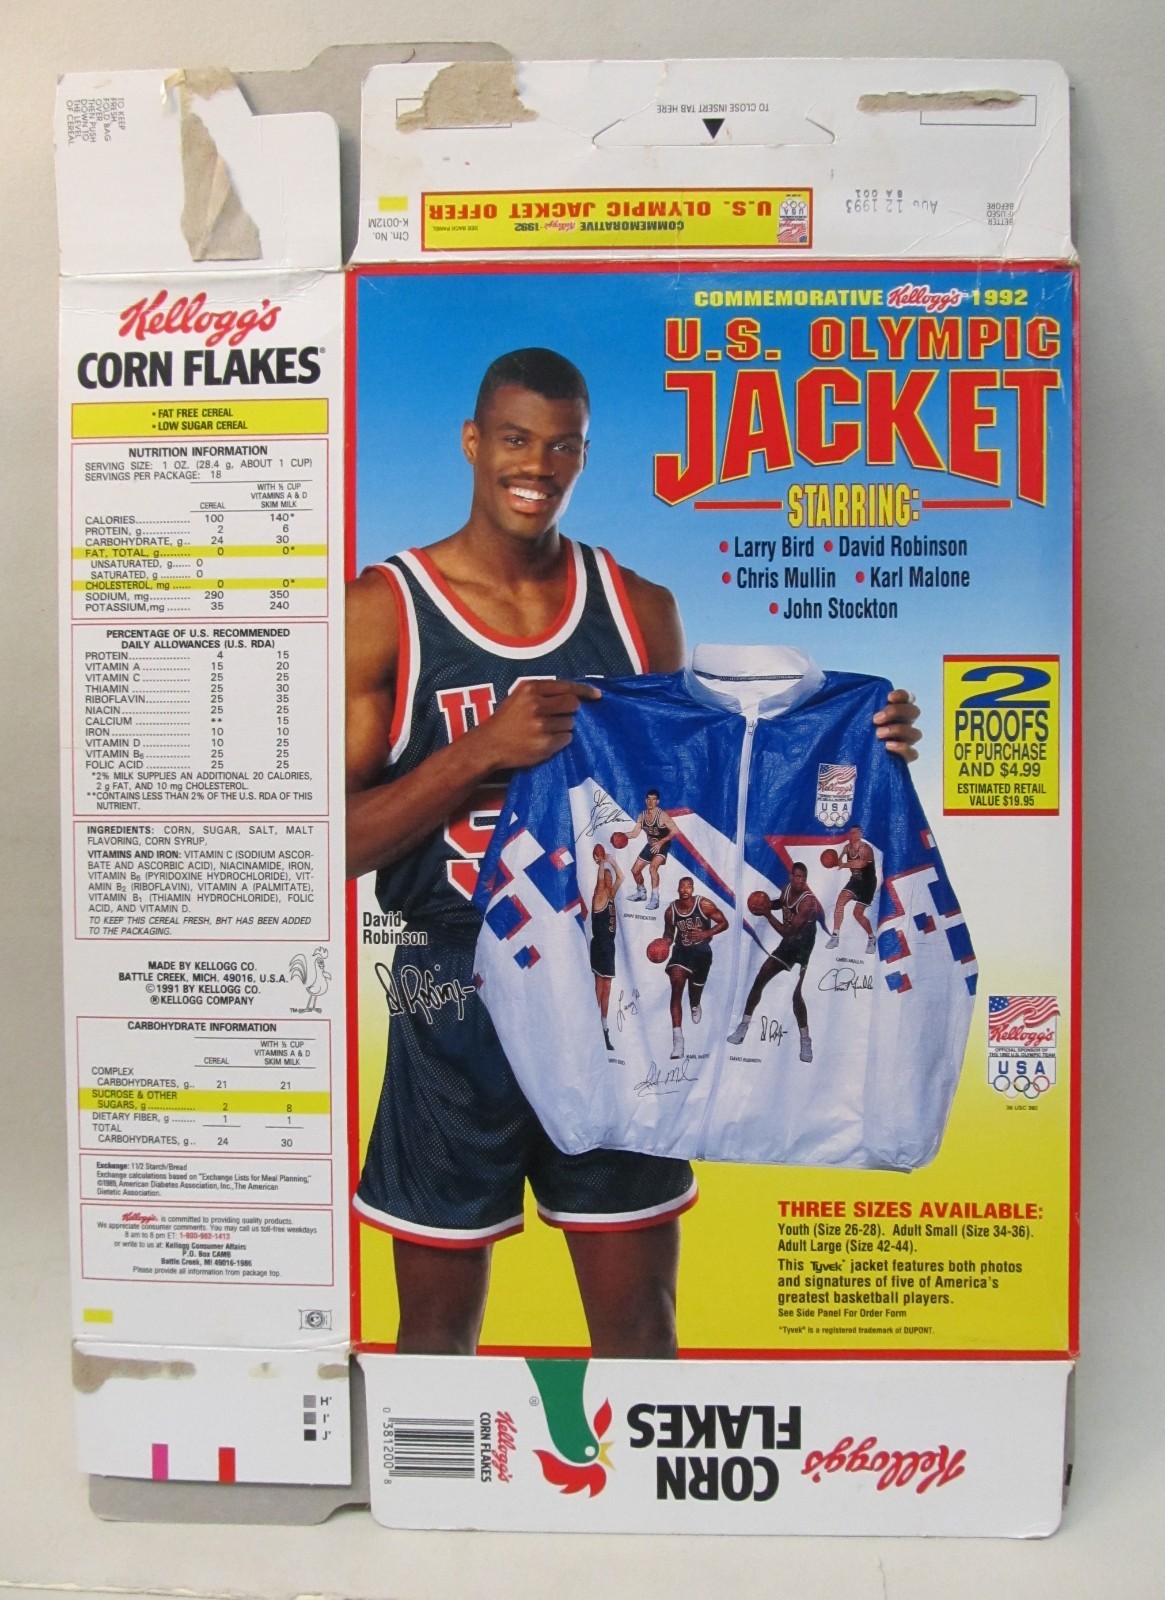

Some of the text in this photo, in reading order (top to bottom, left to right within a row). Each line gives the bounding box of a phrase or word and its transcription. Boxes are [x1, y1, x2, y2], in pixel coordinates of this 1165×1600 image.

[66, 100, 73, 111] OF
[657, 103, 769, 113] TO CLOSE INSERT TAB HERE
[429, 200, 772, 220] U.S. OLYMPIC JACKET OFFER
[846, 199, 877, 213] 1993
[886, 200, 903, 213] 12
[368, 218, 409, 227] K-0012M
[514, 222, 538, 231] 1992
[580, 221, 684, 231] COMMEMORATIVE
[372, 232, 409, 242] Ctn. No.
[695, 283, 1028, 312] COMMEMORATIVE Kellogg's 1992
[119, 289, 281, 347] Kellogg's
[665, 316, 1061, 361] U.S. OLYMPIC
[77, 351, 173, 388] CORN
[158, 408, 233, 418] FAT FREE CEREAL
[158, 421, 248, 431] LOW SUGAR CEREAL
[653, 367, 1061, 506] JACKET
[128, 446, 268, 458] NUTRITION INFORMATION
[85, 470, 222, 481] SERVINGS PER PACKAGE: 18
[787, 484, 920, 527] STARRING:
[734, 536, 815, 562] Larry Bird
[839, 536, 968, 557] David Robinson
[736, 567, 836, 589] Chris Mullin
[870, 566, 970, 588] Karl Malone
[783, 598, 898, 620] John Stockton
[107, 628, 290, 639] PERCENTAGE OF U.S. RECOMMENDED
[121, 639, 275, 649] DAILY ALLOWANCES (U.S. RDA)
[959, 666, 1051, 708] 2
[955, 709, 1049, 742] PROOFS
[954, 743, 1047, 760] OF PURCHASE
[958, 762, 1041, 779] AND $4.99
[958, 783, 1046, 794] ESTIMATED RETAIL
[969, 795, 1034, 807] VALUE $19.95
[362, 911, 402, 928] David
[362, 928, 428, 946] Robinson
[148, 961, 257, 971] MADE BY KELLOGG CO.
[119, 973, 289, 984] BATTLE CREEK, MICH. 49016, U.S.A.
[183, 984, 195, 994] BY
[198, 985, 241, 995] KELLOGG
[244, 985, 261, 995] CO.
[206, 996, 254, 1006] COMPANY
[128, 1021, 277, 1033] CARBOHYDRATE INFORMATION
[990, 1022, 1054, 1046] Kellogg's
[778, 1201, 1043, 1220] THREE SIZES AVAILABLE:
[778, 1223, 1034, 1239] Youth (Size 26-28). Adult Small (Size 34-36).
[778, 1239, 917, 1255] Adult Large (Size 42-44).
[778, 1259, 804, 1271] This
[850, 1259, 888, 1273] jacket
[892, 1260, 944, 1272] features
[949, 1260, 976, 1273] both
[980, 1260, 1023, 1275] photos
[778, 1275, 999, 1290] and signatures of five of America's
[778, 1292, 954, 1306] greatest basketball players.
[778, 1309, 907, 1318] See Side Panel For Order Form
[626, 1403, 802, 1450] FLAKES
[382, 1422, 394, 1470] 381200
[479, 1412, 492, 1483] CORN FLAKES
[494, 1410, 516, 1484] Kellogg's
[801, 1436, 967, 1493] Kellogg's
[656, 1455, 779, 1502] CORN
